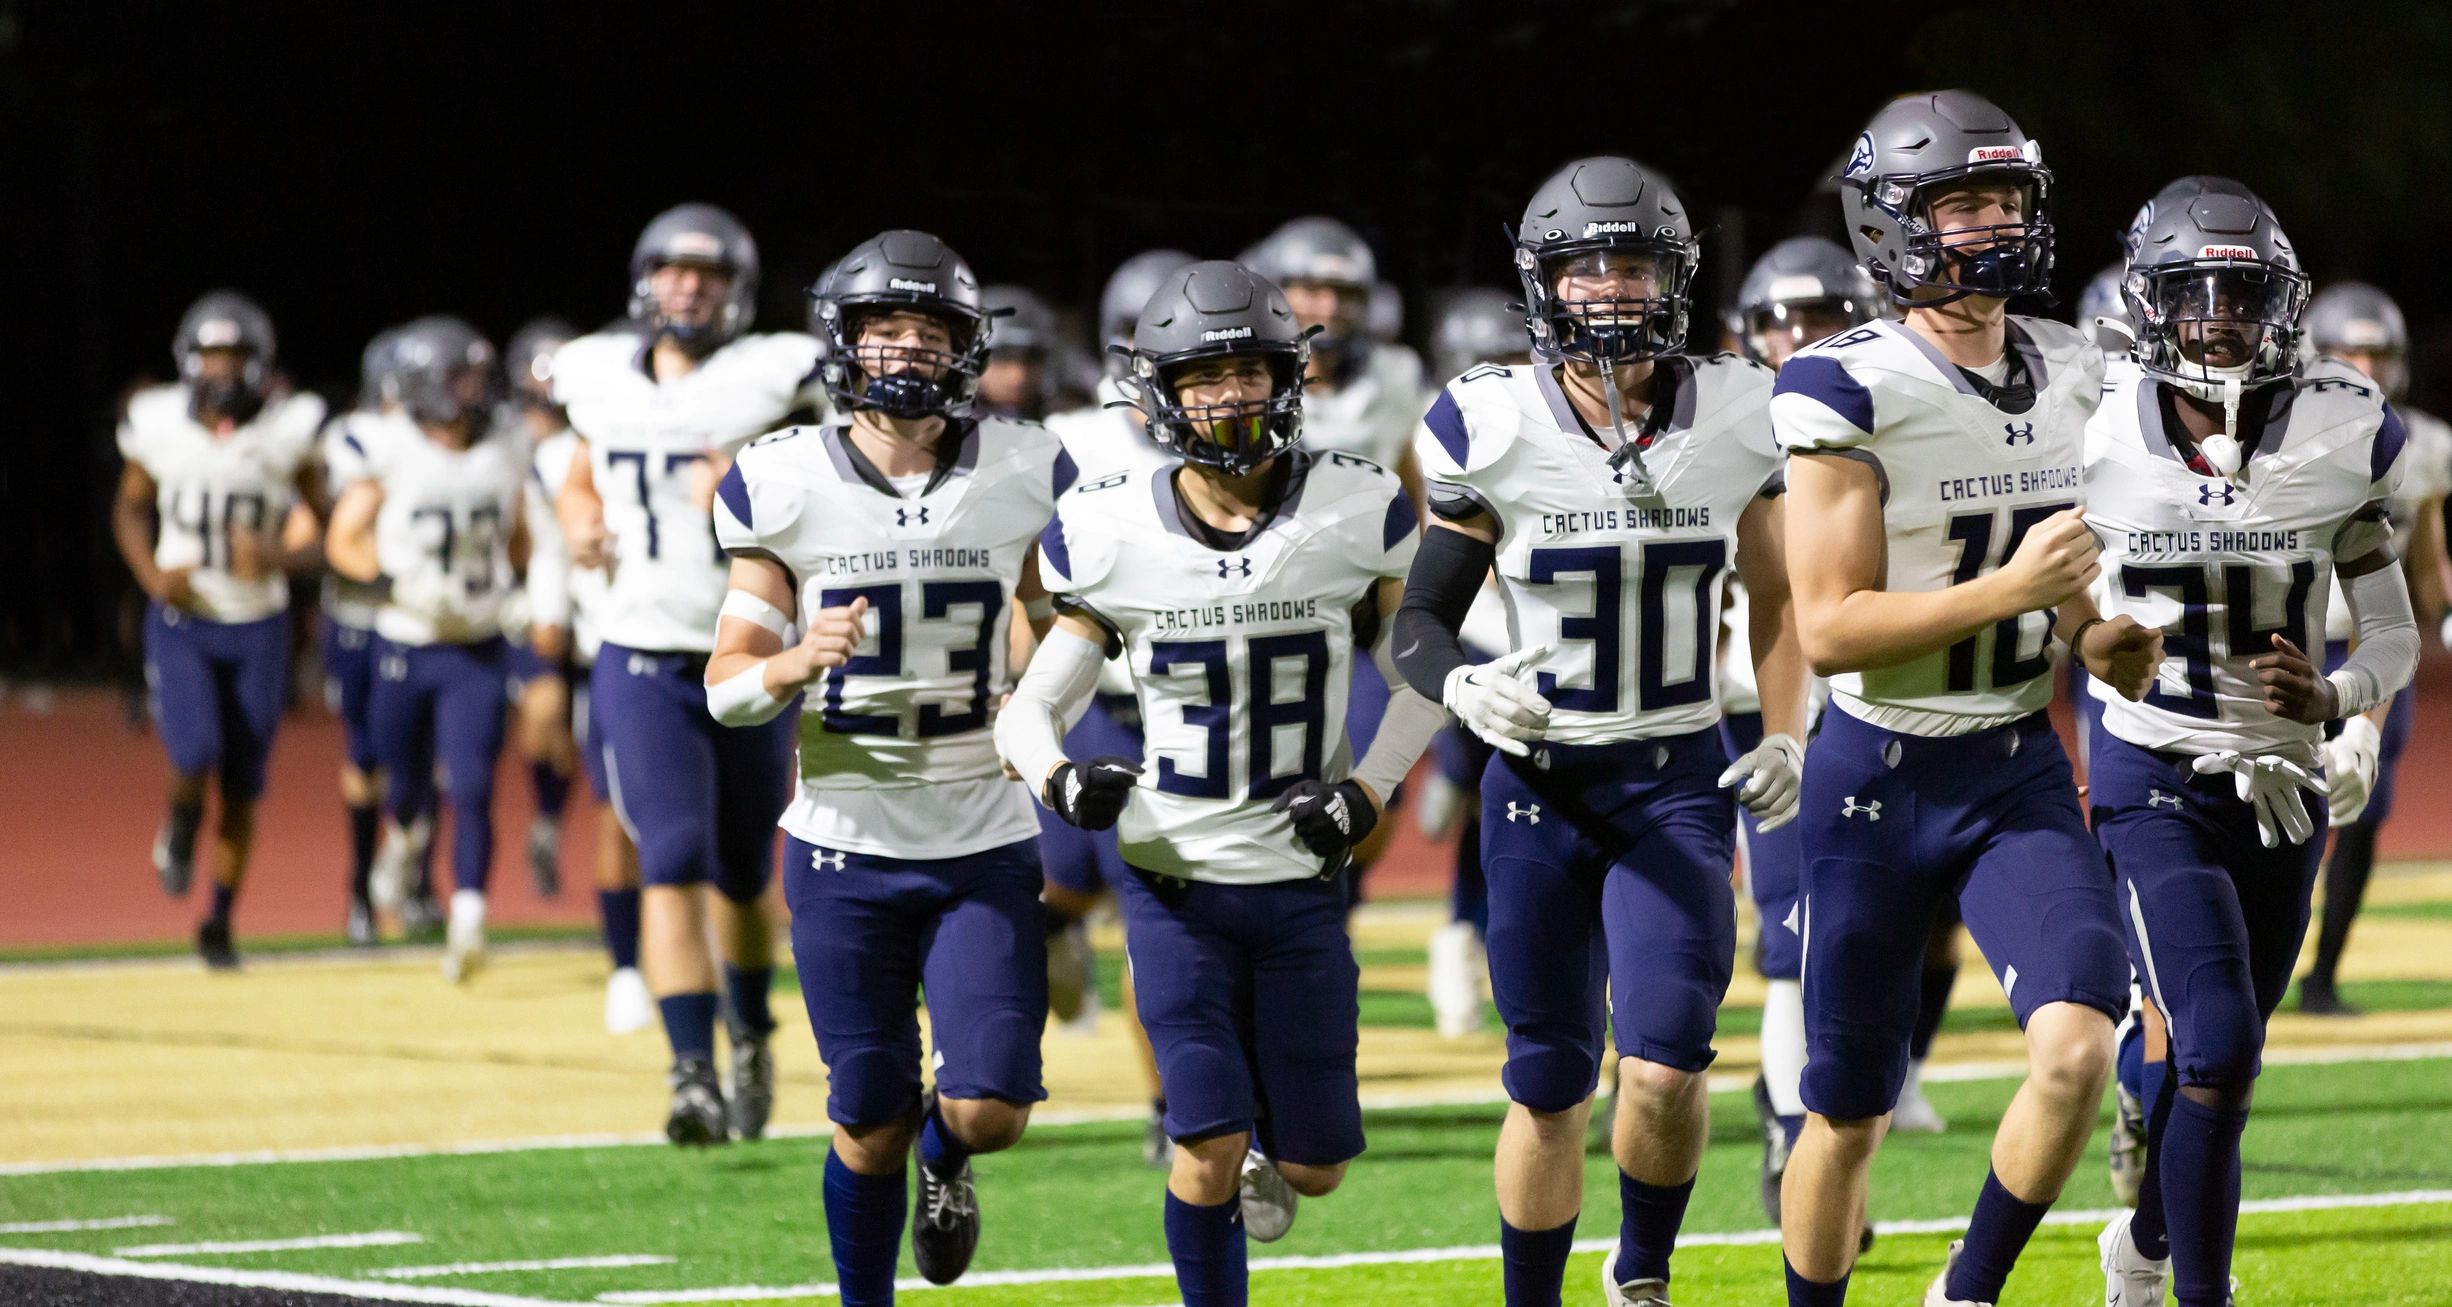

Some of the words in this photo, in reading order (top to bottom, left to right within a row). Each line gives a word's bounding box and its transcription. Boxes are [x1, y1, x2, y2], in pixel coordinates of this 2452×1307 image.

[1977, 148, 2020, 160] Riddell
[1587, 221, 1637, 233] Riddell
[2205, 247, 2253, 259] Riddell
[1205, 326, 1252, 342] Riddell
[1940, 474, 2013, 501] CACTUS
[2020, 467, 2078, 492] SHADOWS
[1542, 511, 1617, 534] CACTUS
[1626, 507, 1709, 529] SHADOWS
[2128, 531, 2200, 552] CACTUS
[2209, 530, 2298, 552] SHADOWS
[827, 551, 898, 575] CACTUS
[908, 548, 990, 568] SHADOWS
[1154, 606, 1225, 630] CACTUS
[1232, 599, 1317, 624] SHADOWS
[1529, 538, 1727, 714] 30
[820, 580, 1006, 738] 23
[1149, 629, 1329, 801] 38
